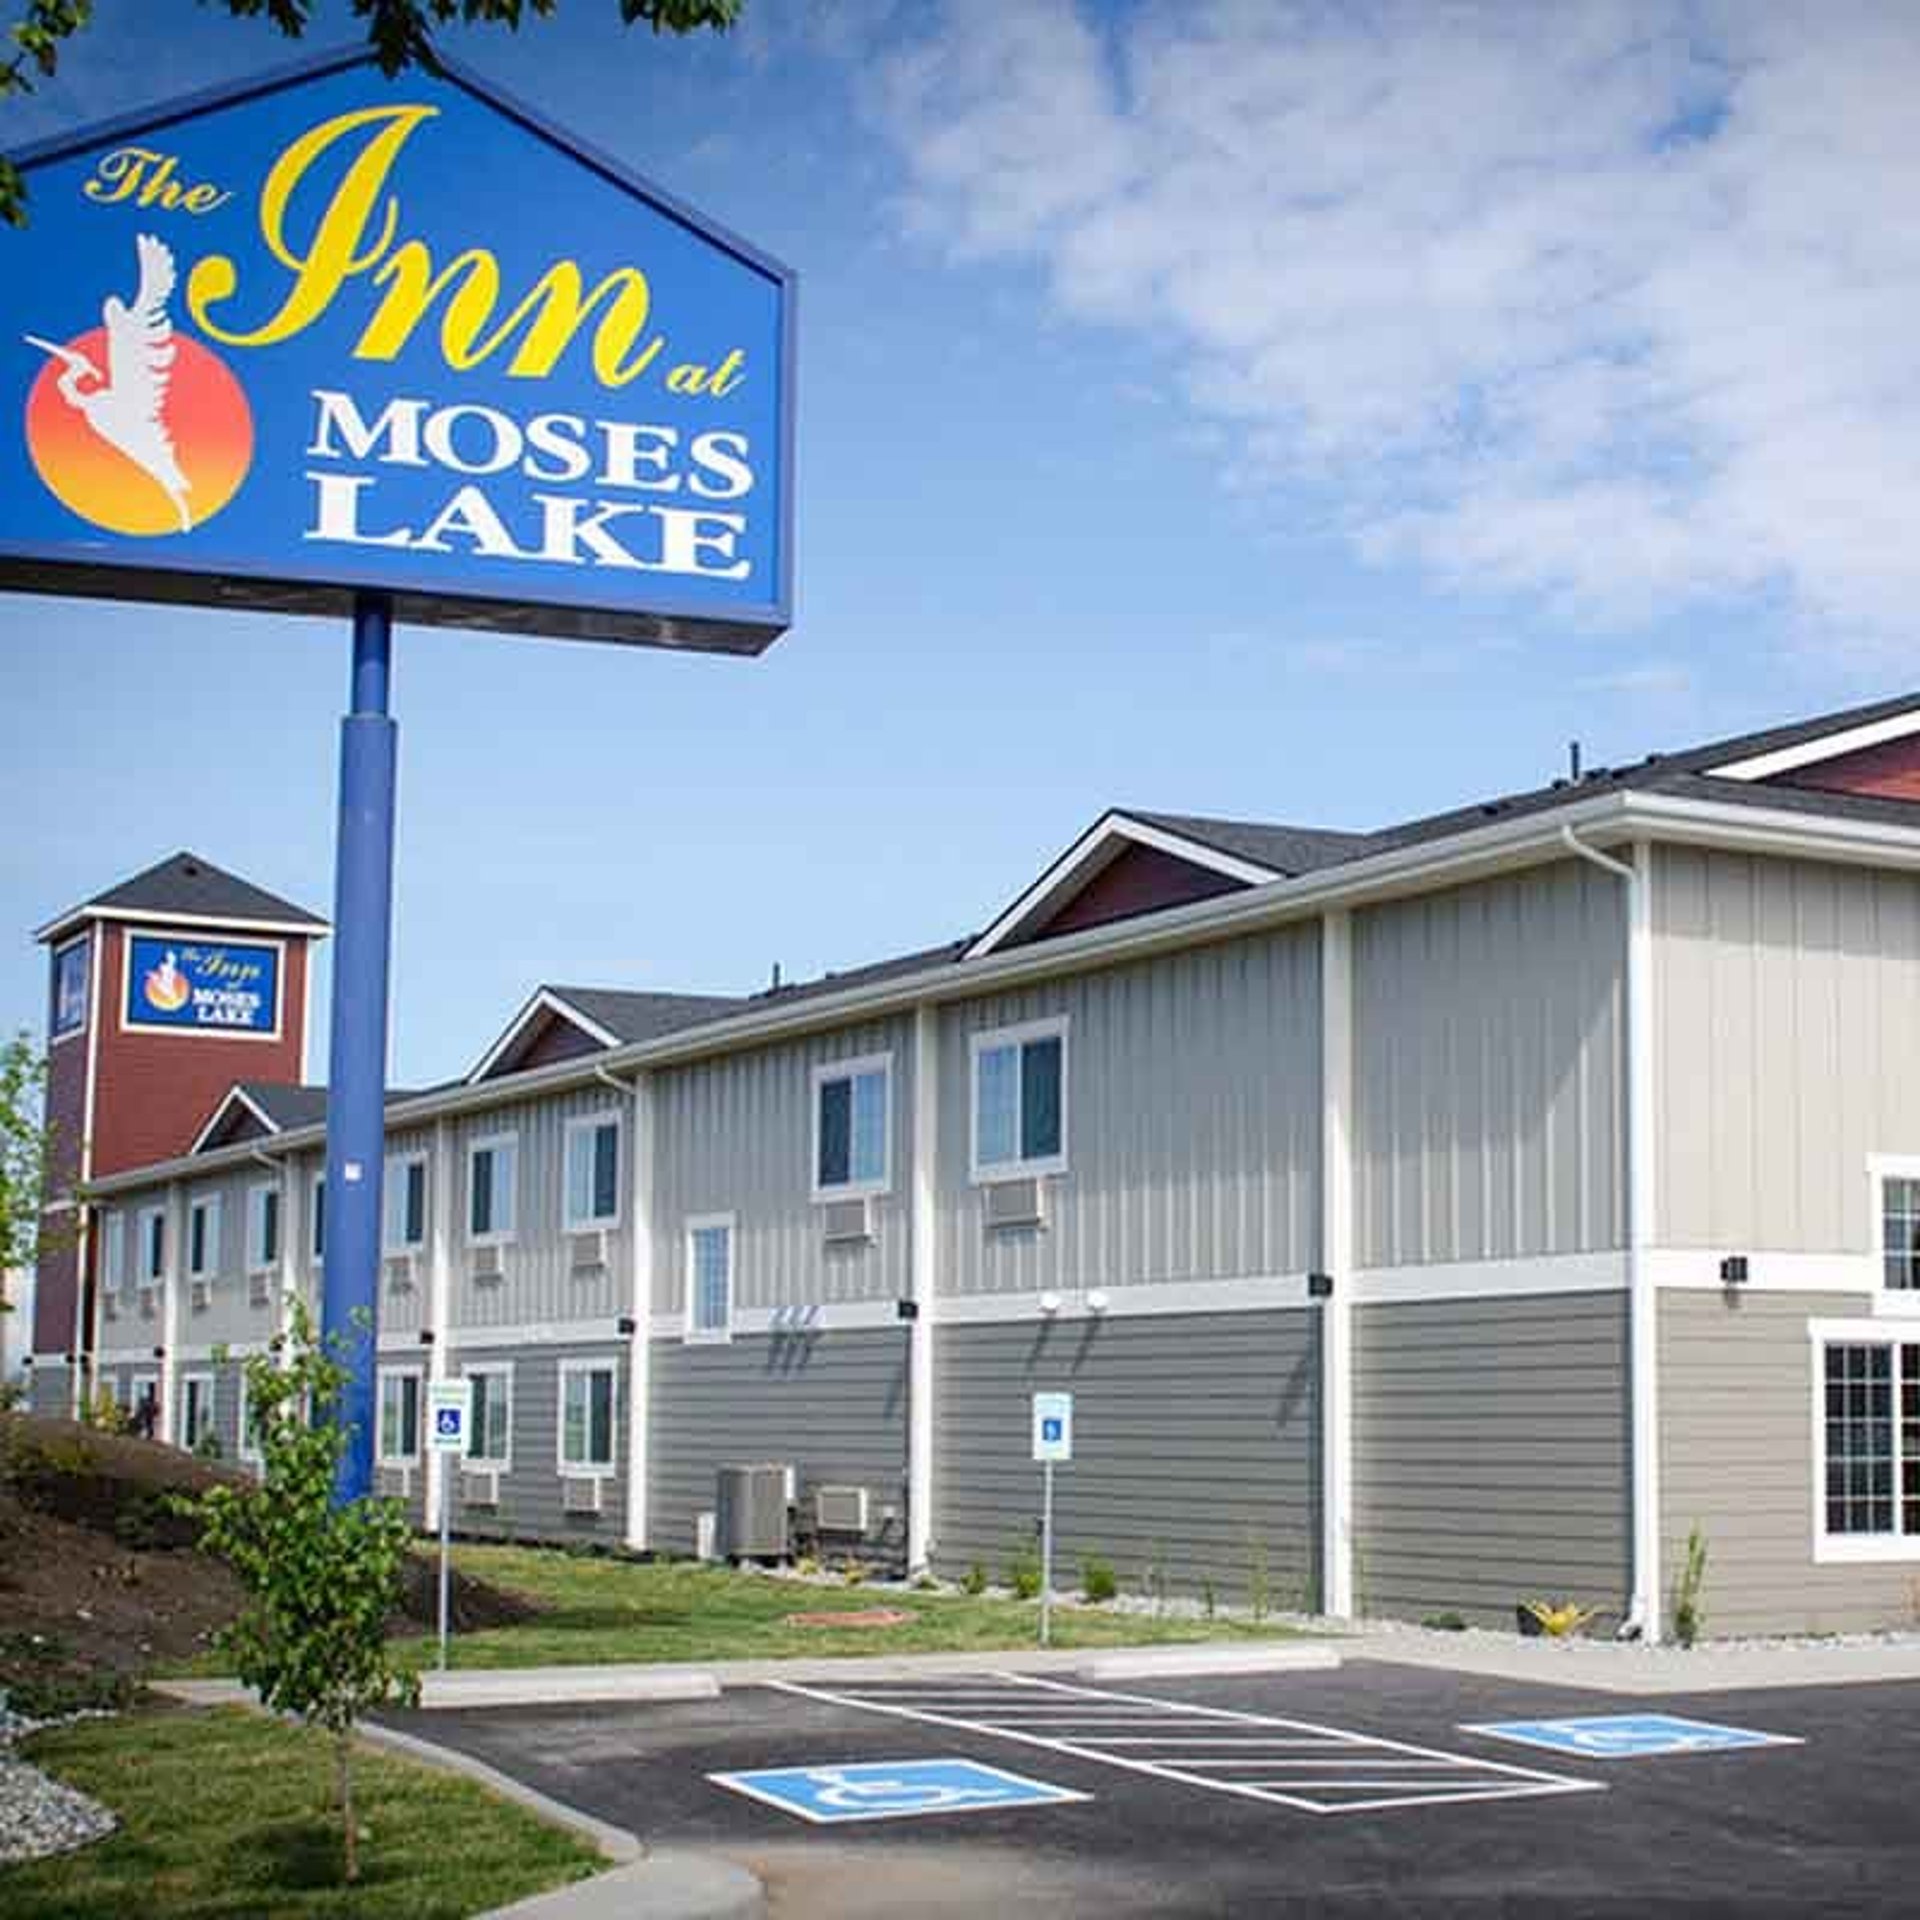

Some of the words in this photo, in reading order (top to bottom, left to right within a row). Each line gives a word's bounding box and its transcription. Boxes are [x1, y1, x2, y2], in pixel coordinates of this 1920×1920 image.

[83, 147, 231, 214] The
[186, 104, 662, 386] Inn
[666, 348, 746, 399] at
[306, 389, 754, 499] MOSES
[302, 471, 750, 580] LAKE
